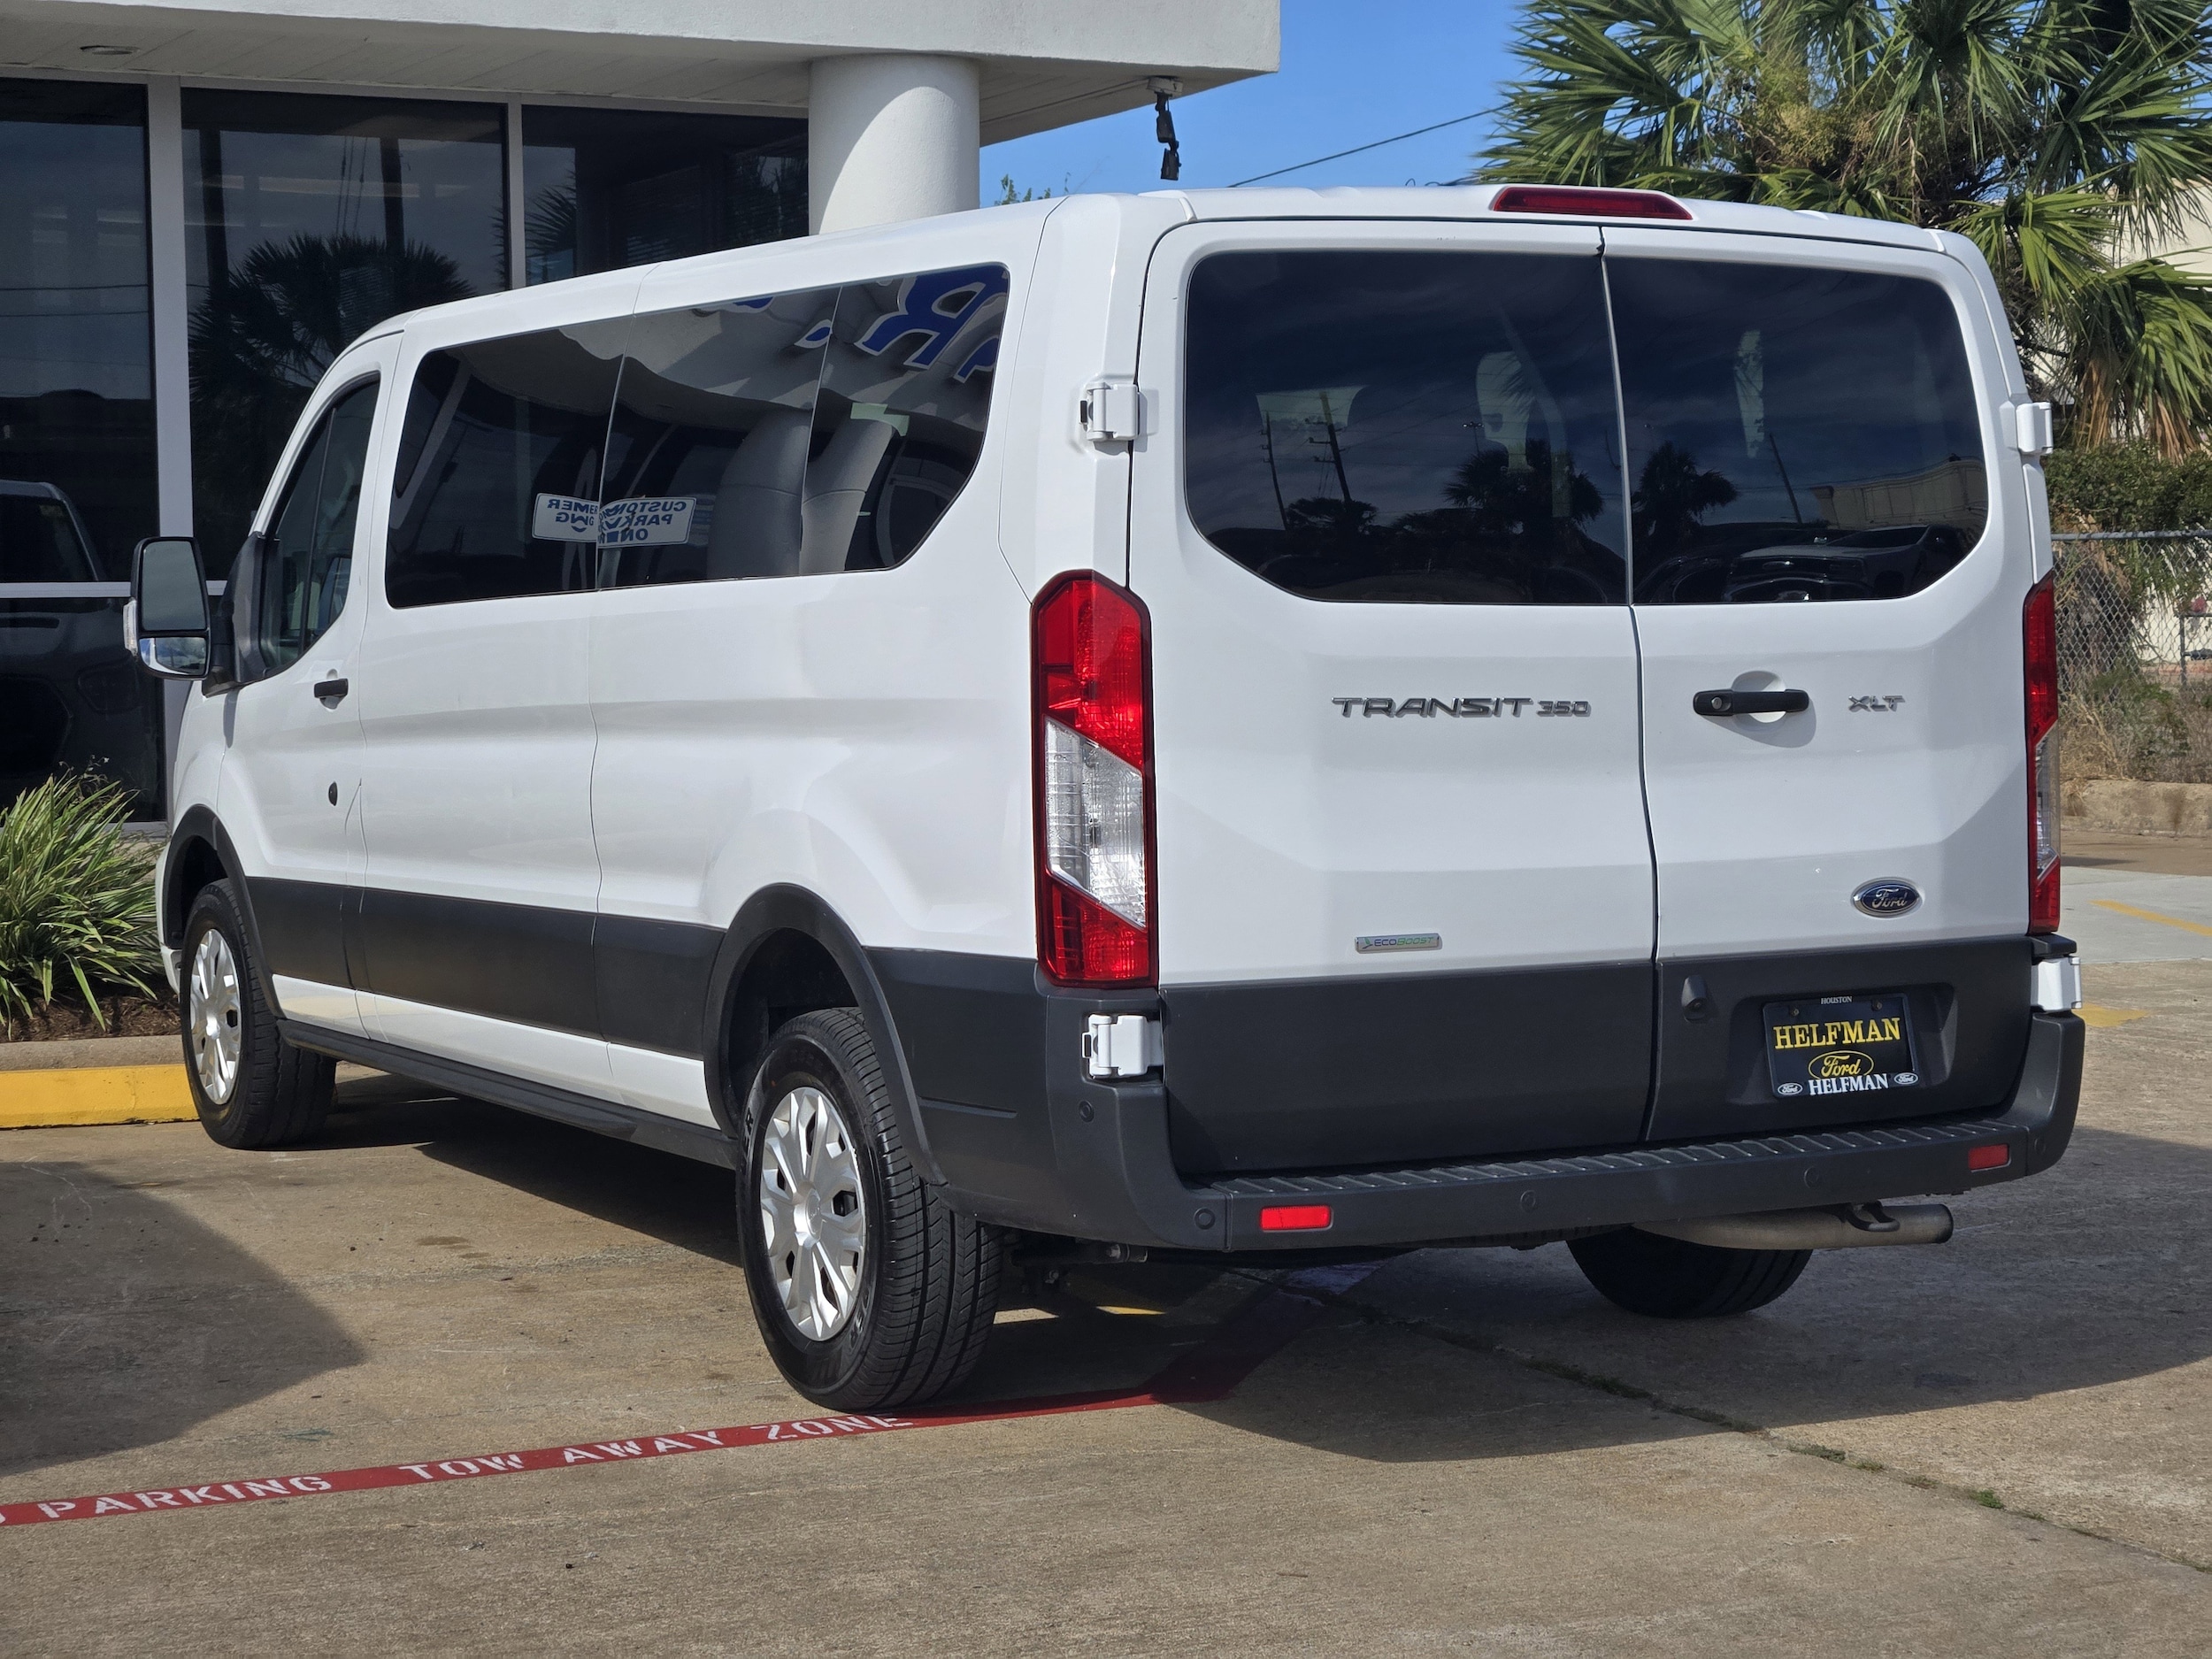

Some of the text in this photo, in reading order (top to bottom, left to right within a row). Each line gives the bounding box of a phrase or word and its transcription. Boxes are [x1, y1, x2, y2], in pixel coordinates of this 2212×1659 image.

[1331, 696, 1592, 718] TRANSIT 350
[1847, 695, 1906, 712] XLT
[1373, 937, 1434, 947] ECOBOOST
[1820, 995, 1854, 1005] HOUSTON
[1773, 1018, 1901, 1050] HELFMAN
[1820, 1054, 1863, 1078] Ford
[1808, 1073, 1890, 1096] HELFMAN
[38, 1415, 914, 1519] PARKING TOW AWAY ZONE
